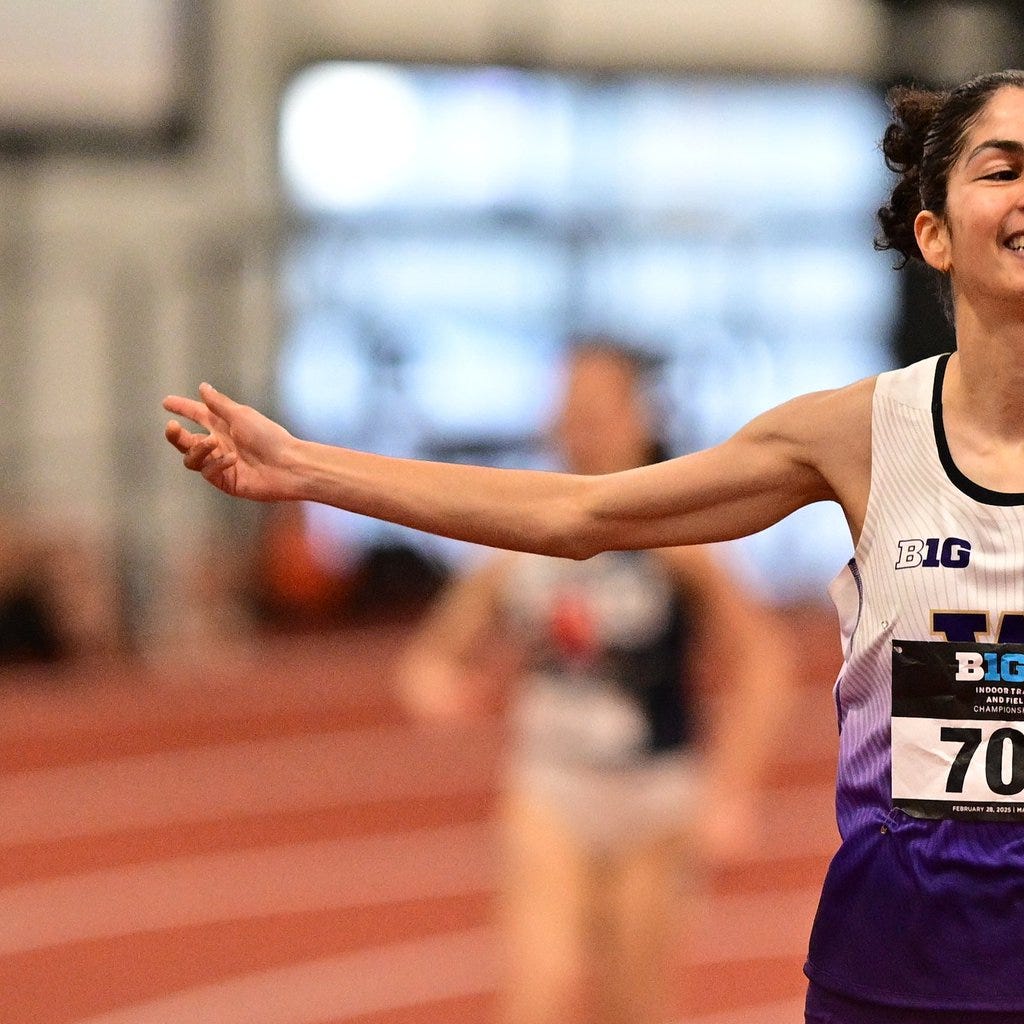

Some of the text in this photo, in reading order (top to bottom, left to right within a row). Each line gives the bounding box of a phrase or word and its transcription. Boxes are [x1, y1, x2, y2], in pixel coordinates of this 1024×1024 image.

[975, 686, 1009, 695] INDOOR
[986, 696, 1005, 704] AND
[952, 805, 984, 813] FEBRUARY
[996, 806, 1012, 814] 2025
